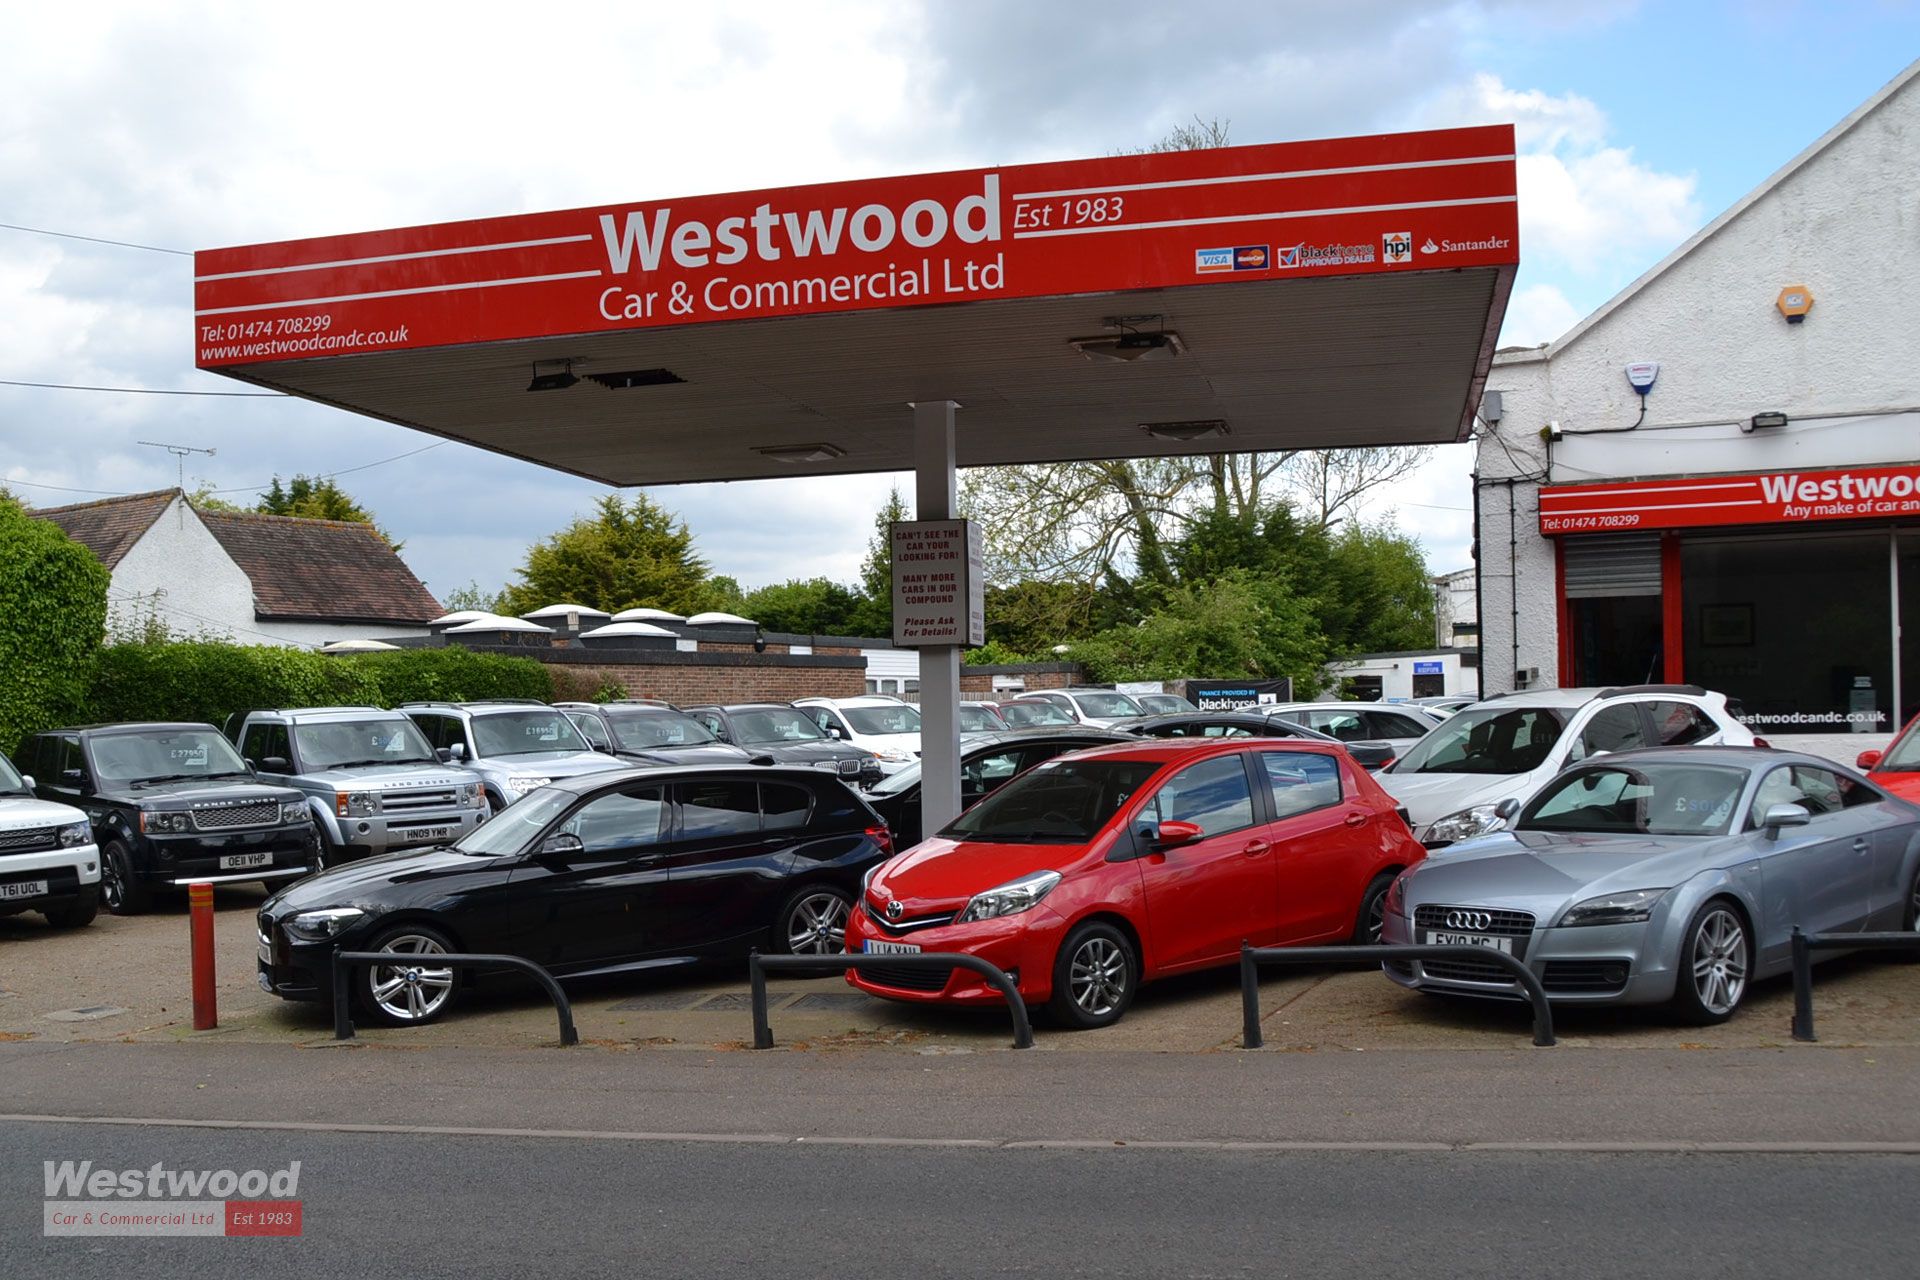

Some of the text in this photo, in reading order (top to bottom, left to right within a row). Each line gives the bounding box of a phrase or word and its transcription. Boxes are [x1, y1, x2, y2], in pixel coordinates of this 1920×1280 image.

[1014, 196, 1124, 230] Est 1983
[599, 174, 1002, 274] Westwood
[1384, 238, 1410, 256] hpi
[1441, 236, 1509, 252] Santander
[1300, 244, 1374, 258] blackhorse
[1202, 256, 1228, 265] VISA
[1300, 254, 1375, 268] APPROVED DEALER
[600, 252, 1004, 321] Car & Commercial Ltd
[201, 314, 331, 342] Tel: 01474 708299
[201, 324, 408, 360] www.westwoodcandc.co.uk
[1760, 474, 1920, 504] Westwo
[1783, 504, 1812, 518] Any
[1814, 501, 1854, 515] make
[1857, 500, 1874, 513] of
[1876, 501, 1898, 512] car
[1543, 514, 1640, 530] Tel: 01474 708299
[896, 530, 960, 540] CAN'T SEE THE
[906, 541, 950, 550] CAR YOUR
[898, 552, 935, 562] LOOKING
[902, 573, 956, 582] MANY MORE
[940, 584, 957, 592] OUR
[905, 595, 954, 604] COMPOUND
[904, 616, 954, 626] Please Ask
[903, 628, 957, 637] For Details!
[1199, 698, 1256, 710] blackhorse
[407, 828, 430, 839] HN09
[248, 854, 266, 864] VHP
[21, 882, 41, 894] UOL
